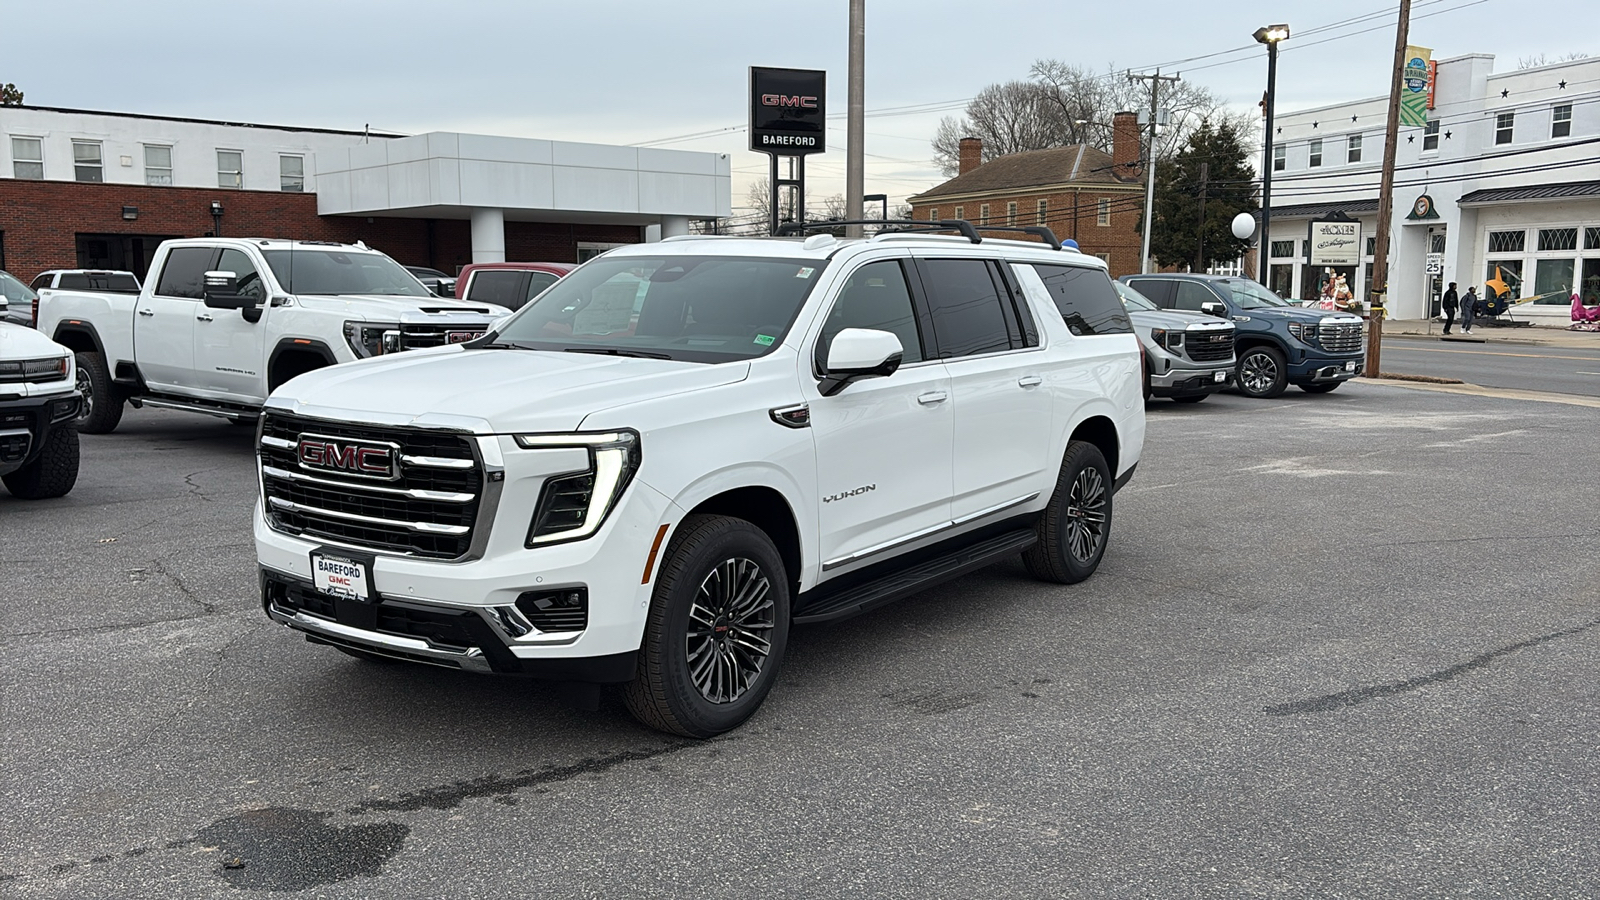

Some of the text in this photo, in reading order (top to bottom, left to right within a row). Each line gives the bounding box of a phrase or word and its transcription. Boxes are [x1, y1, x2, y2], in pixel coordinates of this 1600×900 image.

[762, 94, 817, 107] GMC
[763, 135, 816, 145] BAREFORD
[1427, 264, 1439, 272] 25
[450, 333, 486, 343] GM
[300, 441, 390, 474] GMC
[823, 484, 876, 503] YUKON
[318, 561, 361, 578] BAREFORD
[329, 575, 351, 586] GMC
